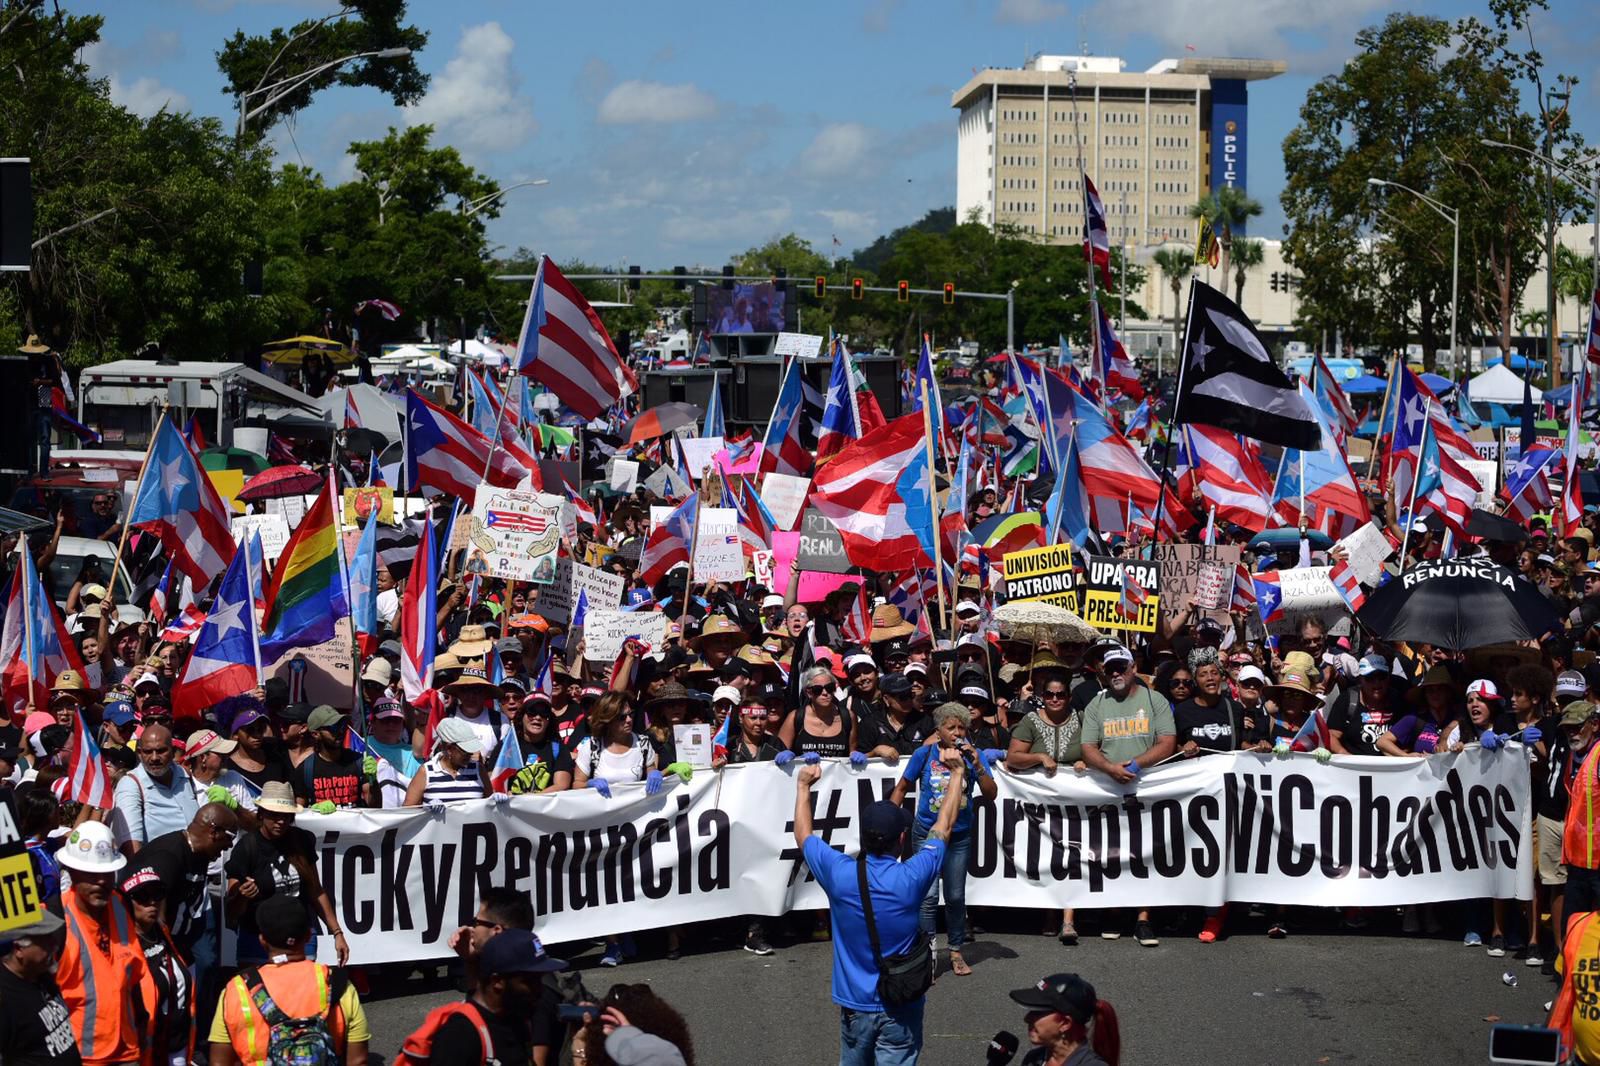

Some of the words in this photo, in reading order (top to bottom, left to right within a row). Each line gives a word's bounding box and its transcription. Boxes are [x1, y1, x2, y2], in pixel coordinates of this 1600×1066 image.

[1224, 135, 1237, 194] POLICI
[1006, 547, 1070, 575] UNIVISIÓN
[1008, 572, 1073, 599] PATRONO
[1091, 562, 1158, 589] UPAGRA
[1402, 565, 1516, 590] RENUNCIA
[1087, 598, 1156, 627] PRESTE
[308, 794, 731, 944] ickyRenuncia
